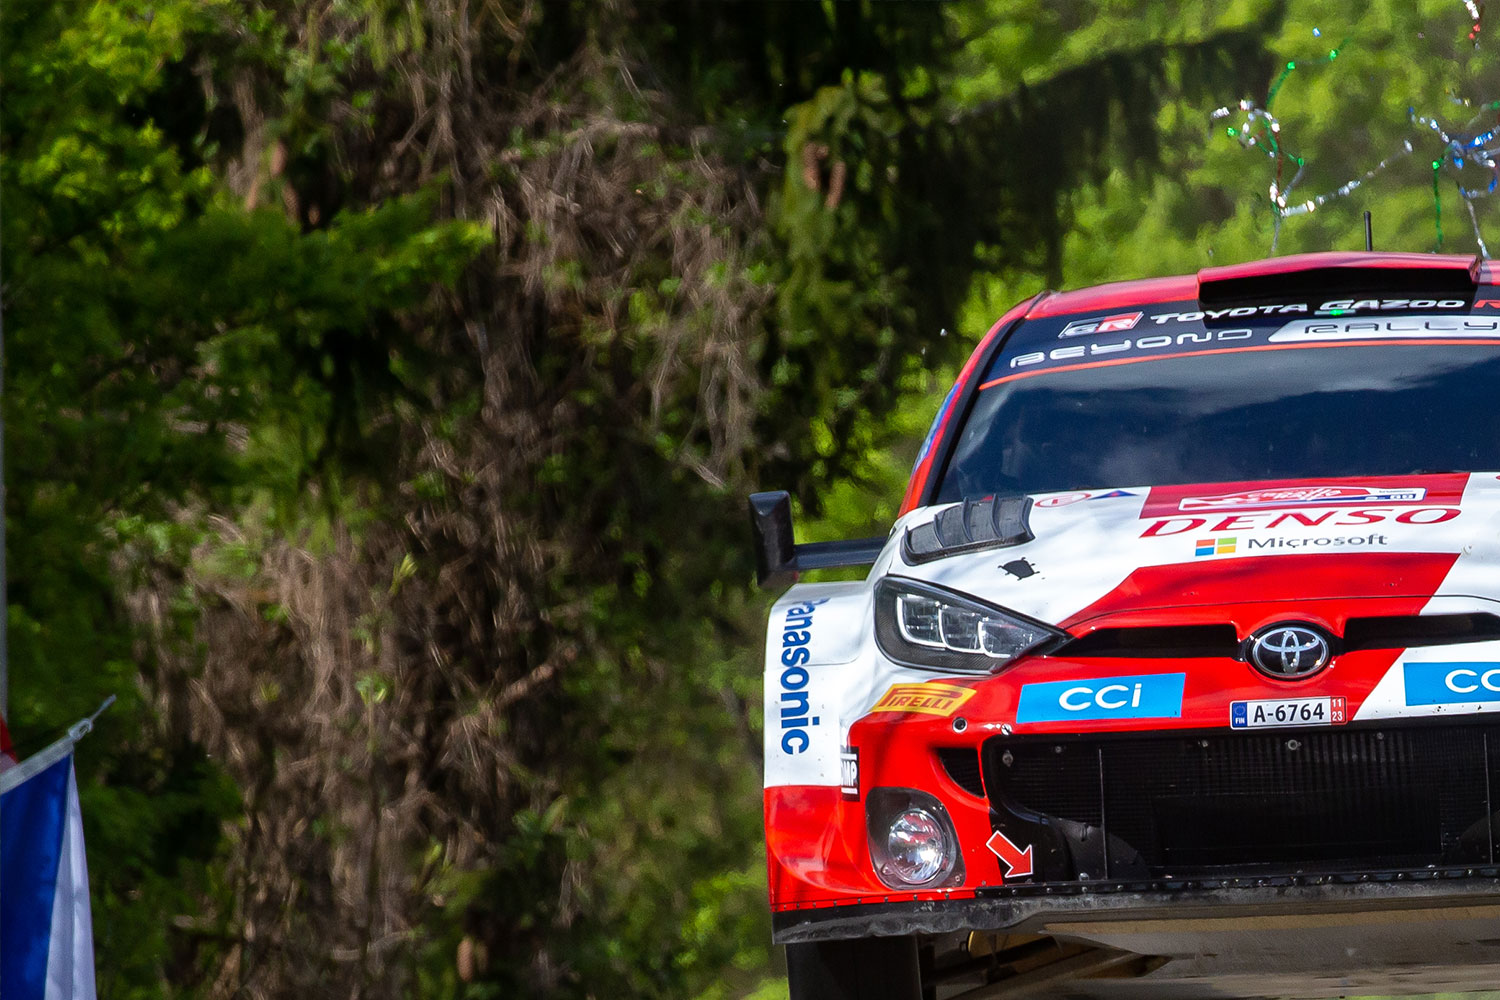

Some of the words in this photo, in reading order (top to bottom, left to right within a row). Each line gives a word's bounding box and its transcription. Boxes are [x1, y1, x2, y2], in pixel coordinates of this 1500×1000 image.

[1062, 316, 1138, 337] GR
[1150, 303, 1309, 325] TOYOTA
[1319, 298, 1466, 312] GAZOO
[1009, 328, 1253, 369] BEYOND
[1303, 320, 1499, 334] RALLY
[1139, 507, 1462, 539] DENSO
[1247, 533, 1389, 549] Microsoft
[878, 686, 963, 712] PIRELLI
[1332, 699, 1342, 708] 11
[1235, 716, 1246, 725] FIN
[1253, 702, 1325, 723] A-6764
[1332, 711, 1343, 722] 23
